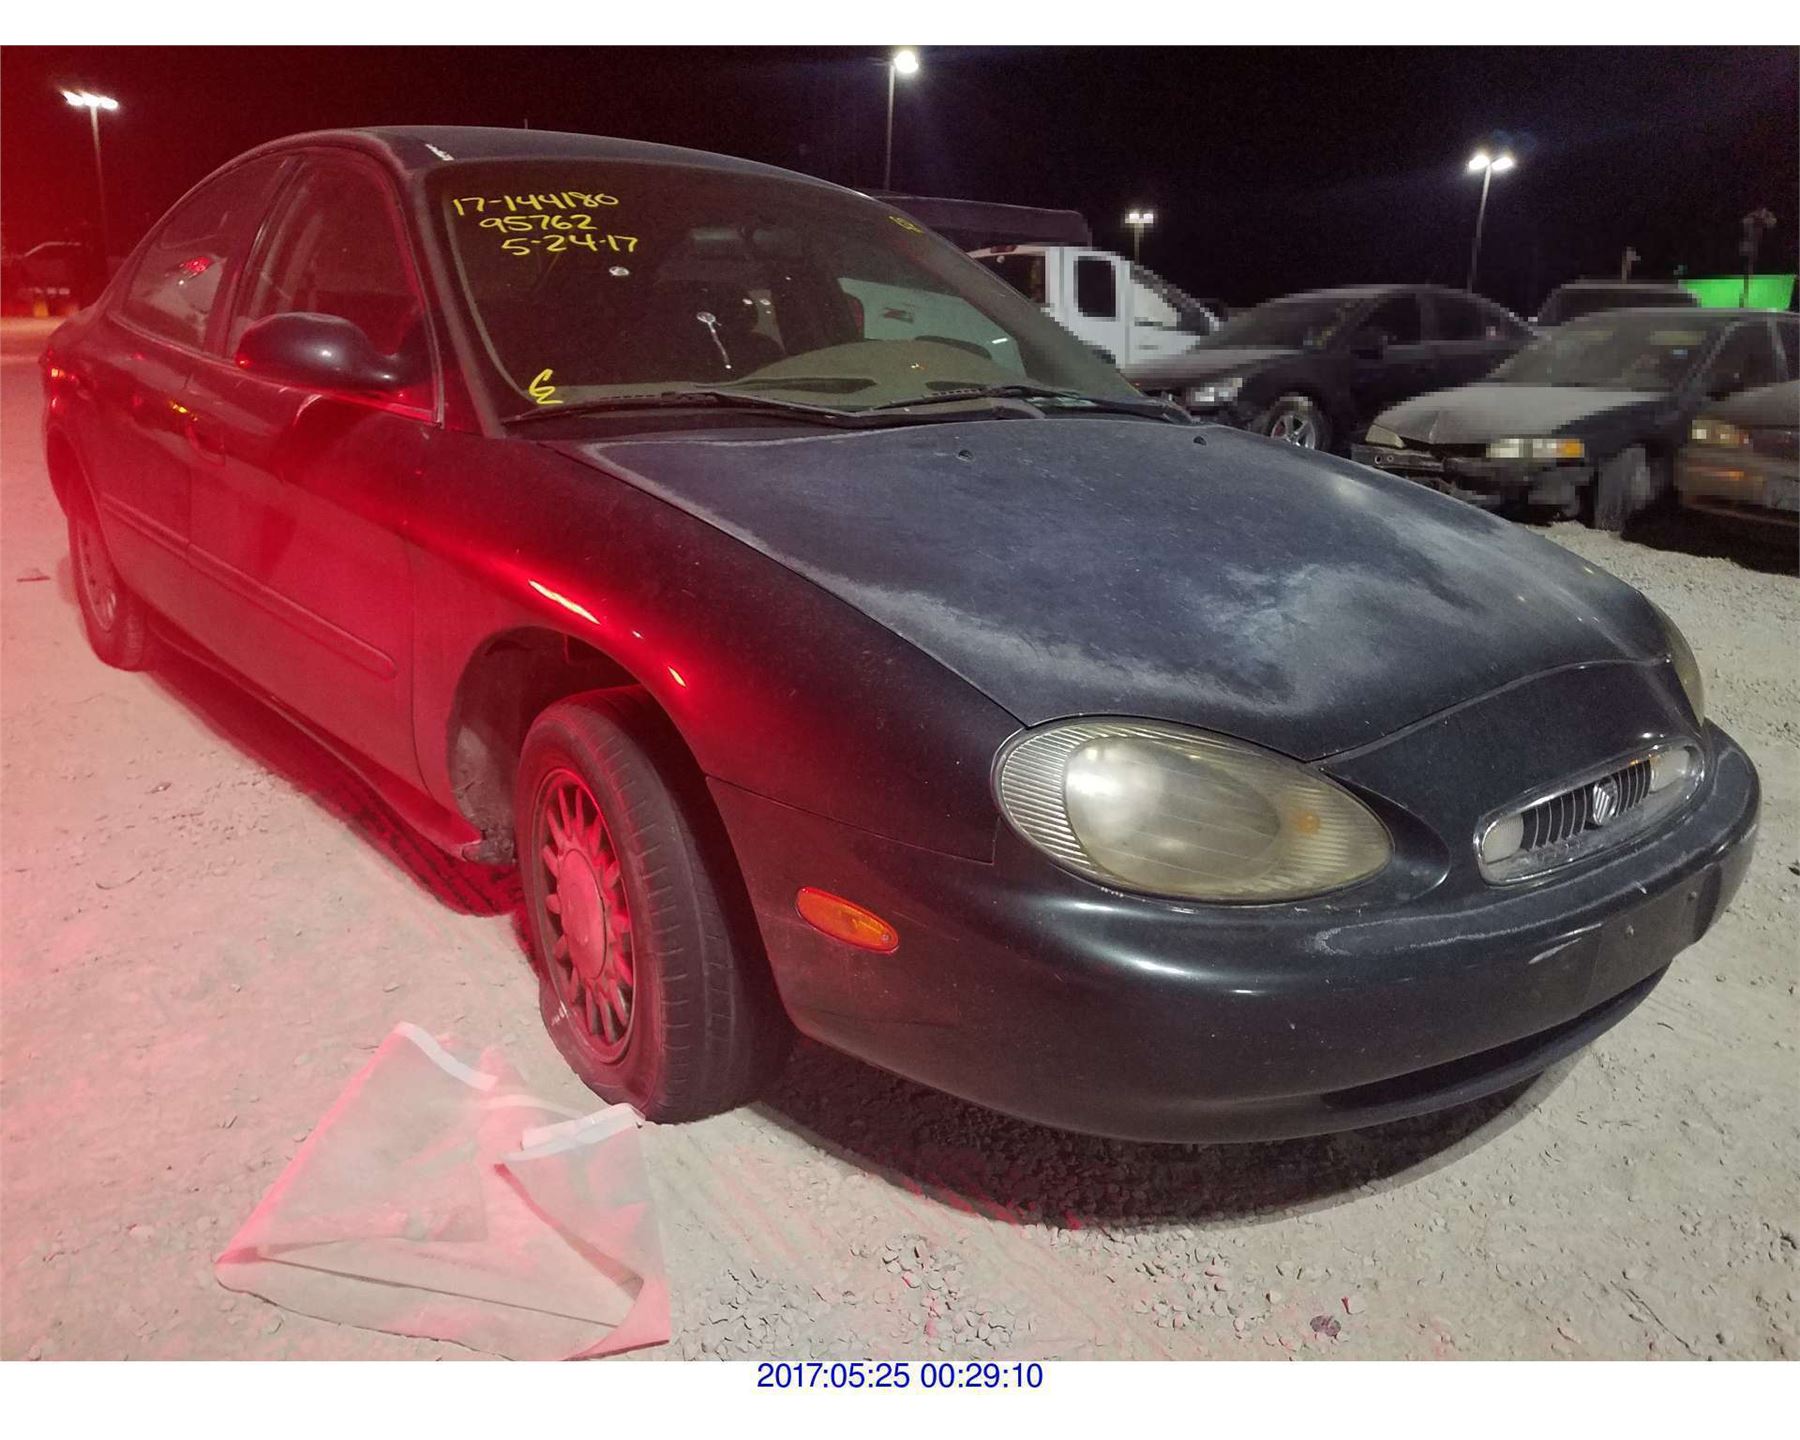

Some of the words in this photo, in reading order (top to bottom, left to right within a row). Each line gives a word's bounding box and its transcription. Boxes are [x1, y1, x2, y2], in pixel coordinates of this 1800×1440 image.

[453, 192, 620, 216] 17-144180
[479, 214, 600, 233] 95762
[501, 234, 639, 256] 5-24-17
